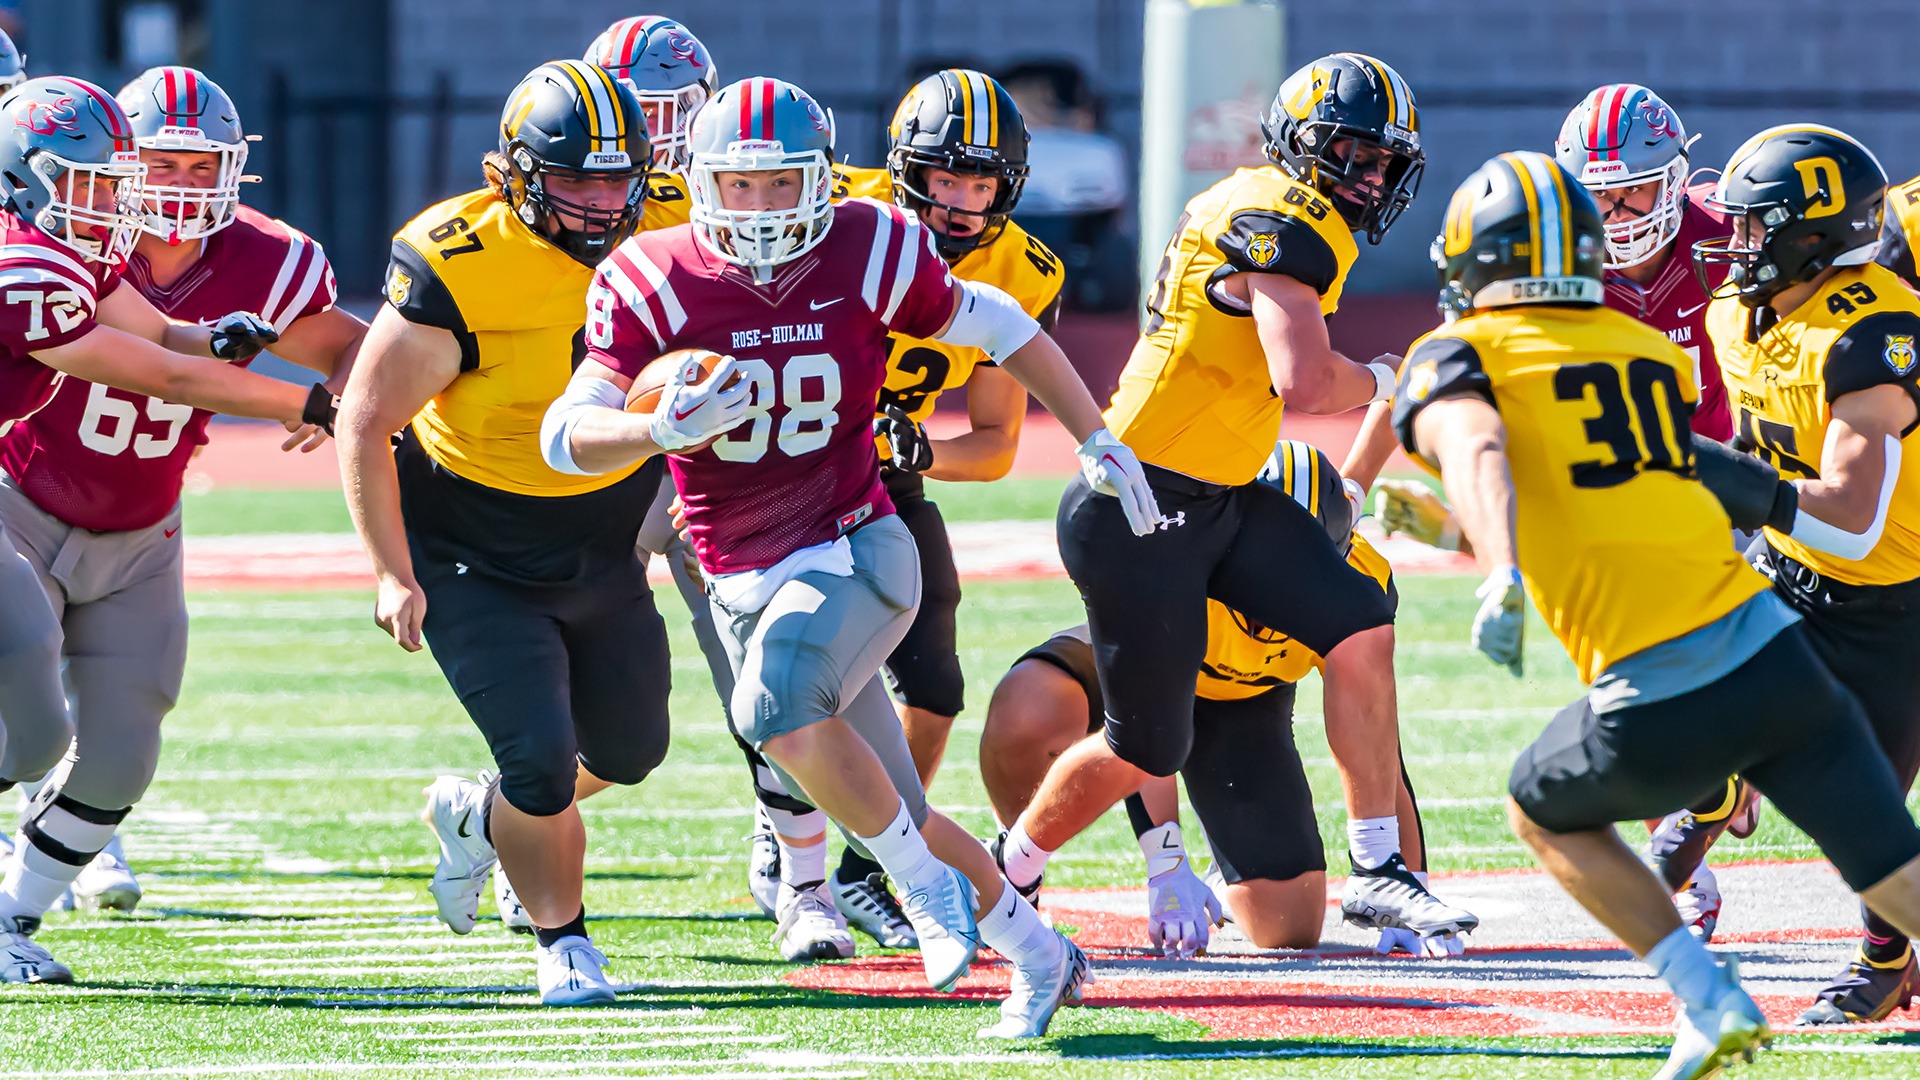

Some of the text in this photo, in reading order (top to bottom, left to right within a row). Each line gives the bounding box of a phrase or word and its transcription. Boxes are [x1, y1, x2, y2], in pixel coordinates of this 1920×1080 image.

[593, 154, 625, 164] TIGERS
[1283, 186, 1331, 221] 65
[1794, 156, 1846, 220] D
[428, 216, 485, 261] 67
[1025, 235, 1057, 278] 42
[6, 290, 88, 341] 72
[731, 323, 824, 349] ROSE-HULMAN
[1553, 358, 1697, 489] 30
